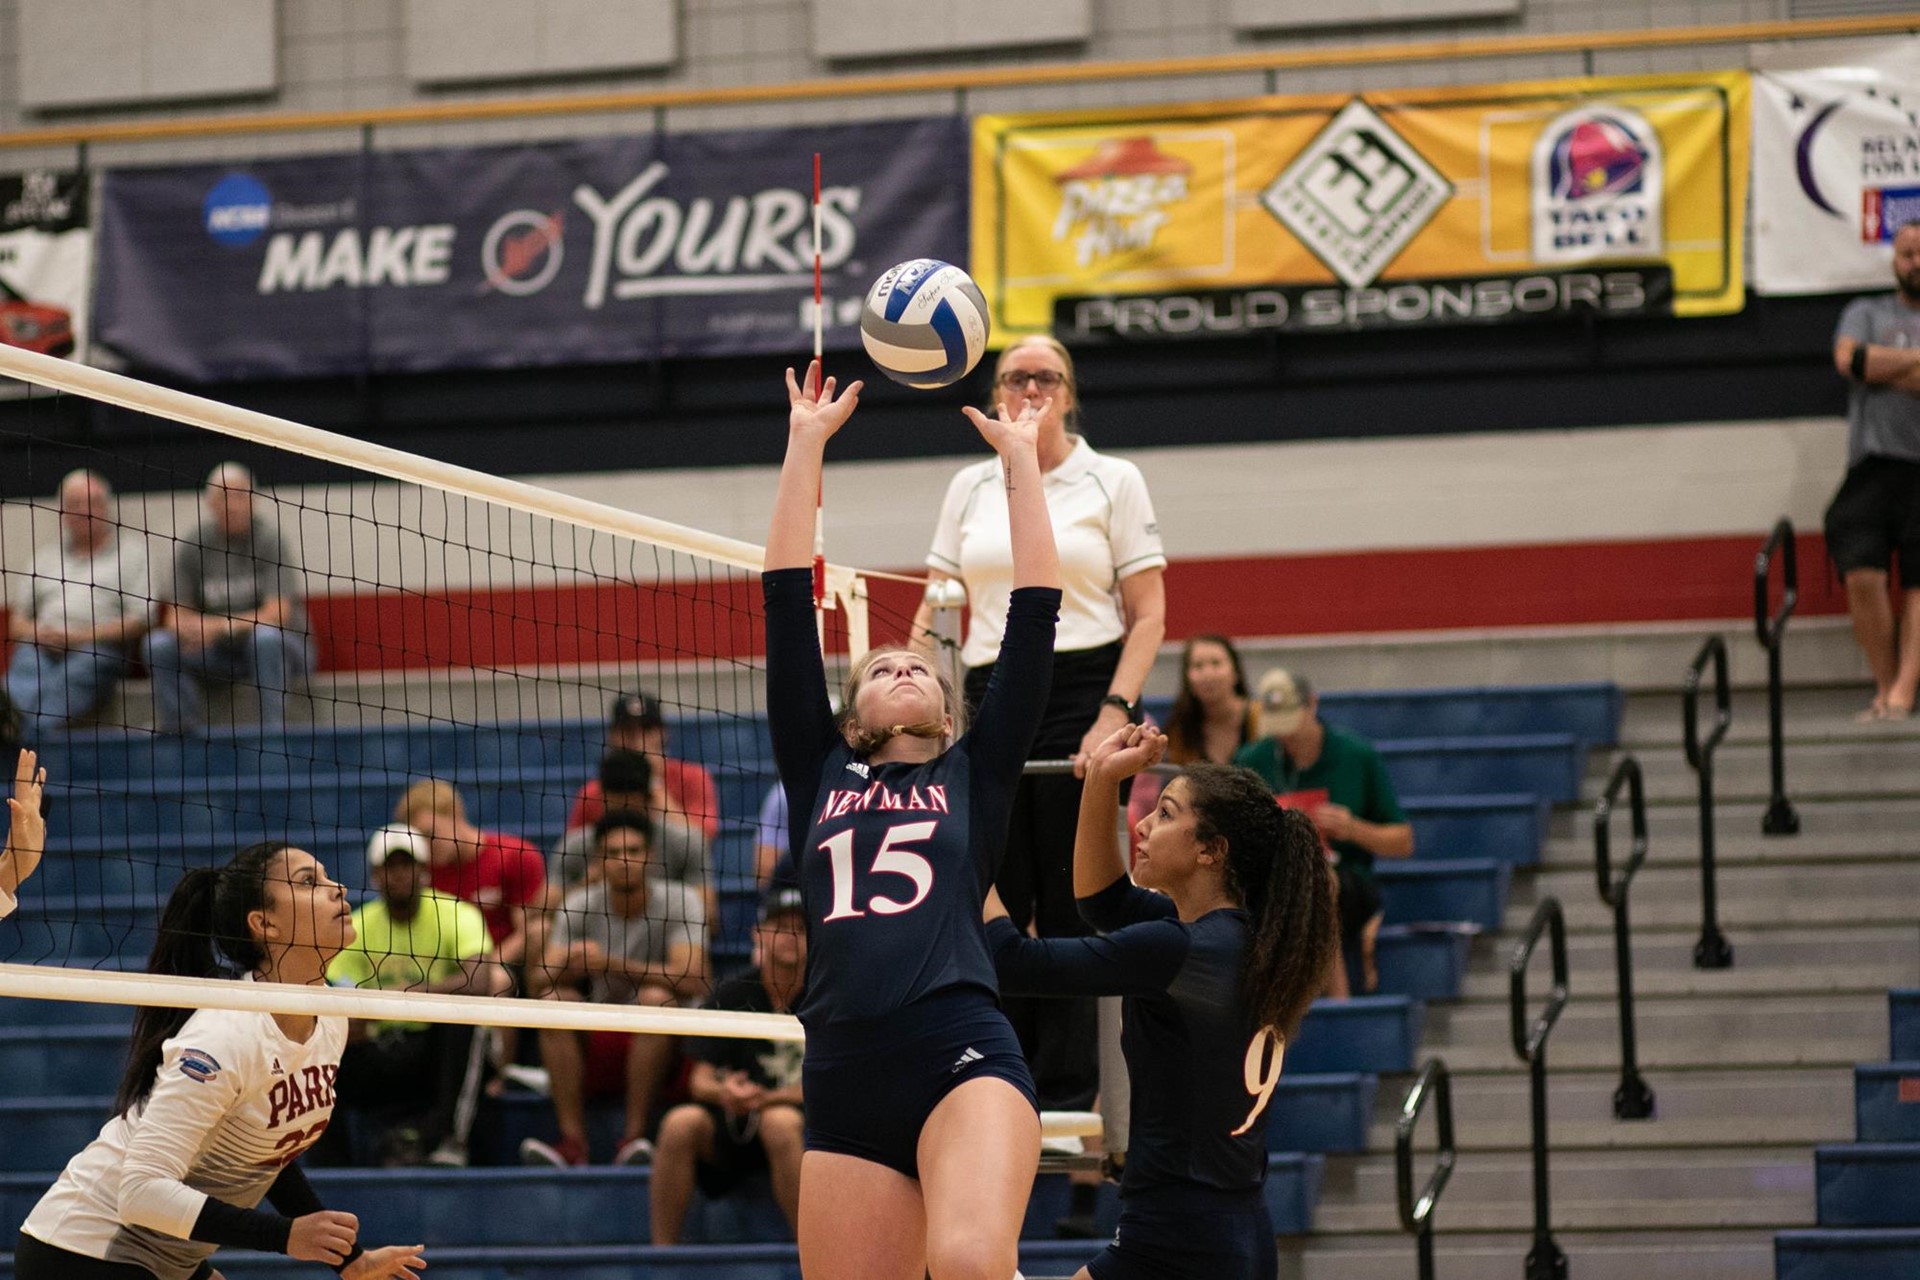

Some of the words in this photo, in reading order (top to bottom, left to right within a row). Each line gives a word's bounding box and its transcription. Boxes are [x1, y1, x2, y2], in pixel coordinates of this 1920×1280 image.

[259, 225, 456, 294] MAKE
[574, 161, 861, 309] YOURS
[1551, 206, 1645, 225] TACO
[1075, 290, 1289, 337] PROUD
[1301, 272, 1646, 330] SPONSORS
[817, 780, 949, 825] NEWMAN
[817, 820, 939, 923] 15
[1230, 1024, 1286, 1137] 9
